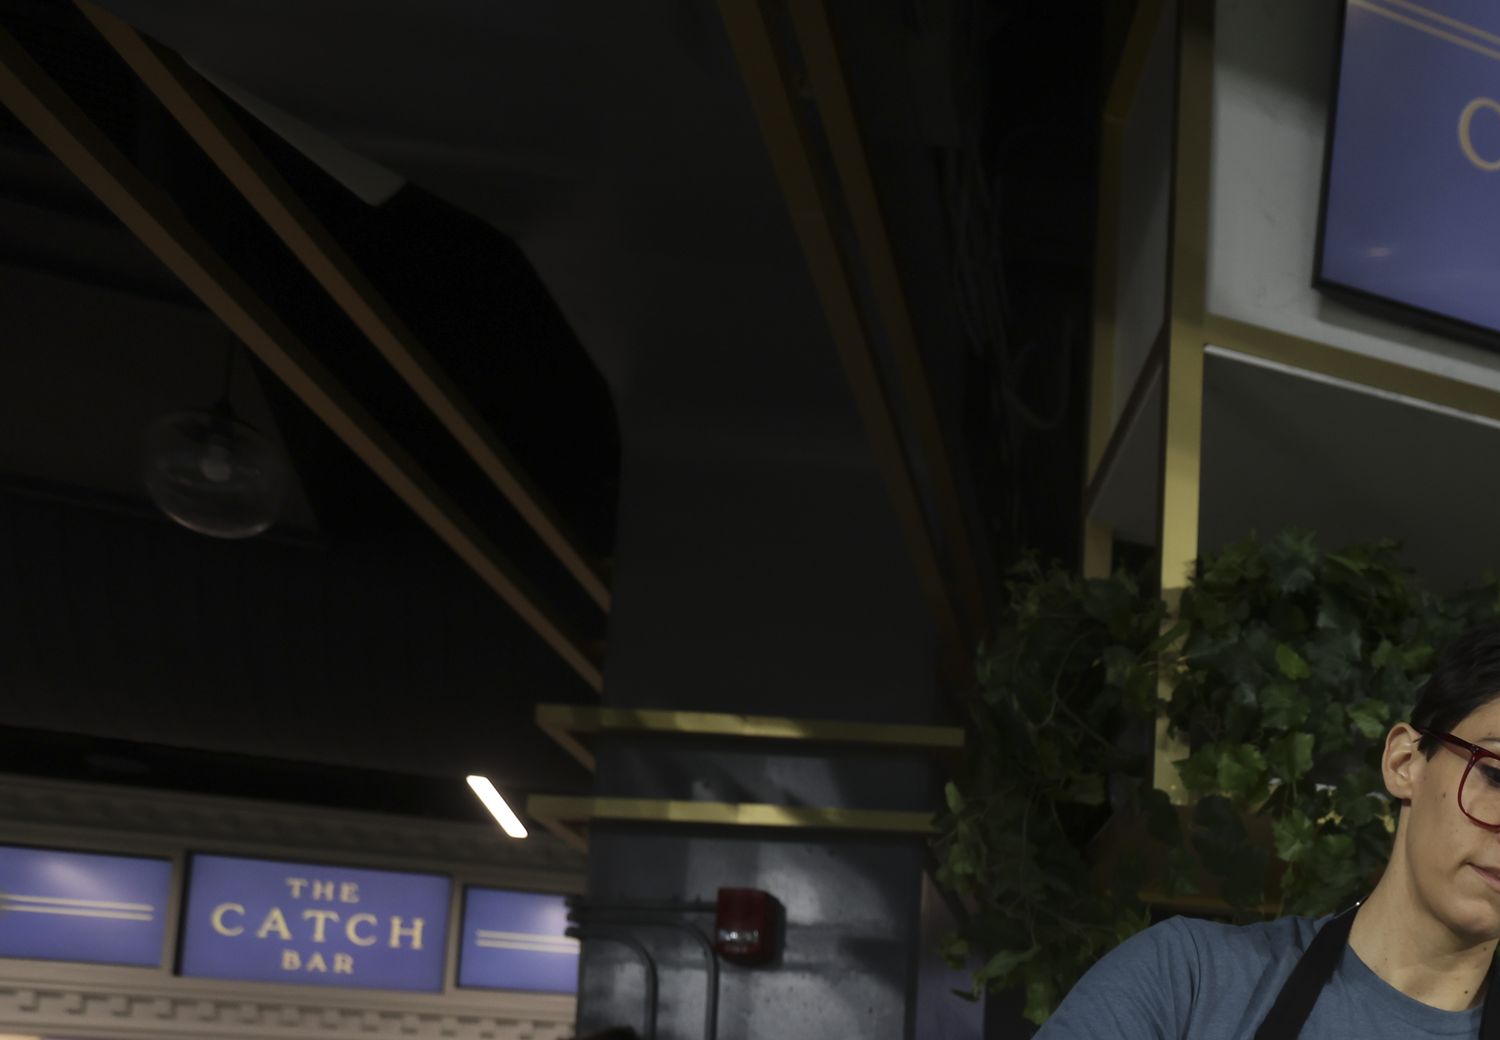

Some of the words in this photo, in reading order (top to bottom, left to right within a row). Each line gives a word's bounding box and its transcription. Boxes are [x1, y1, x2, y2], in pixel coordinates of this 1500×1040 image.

[286, 877, 360, 904] THE
[211, 902, 425, 950] CATCH
[281, 950, 354, 975] BAR
